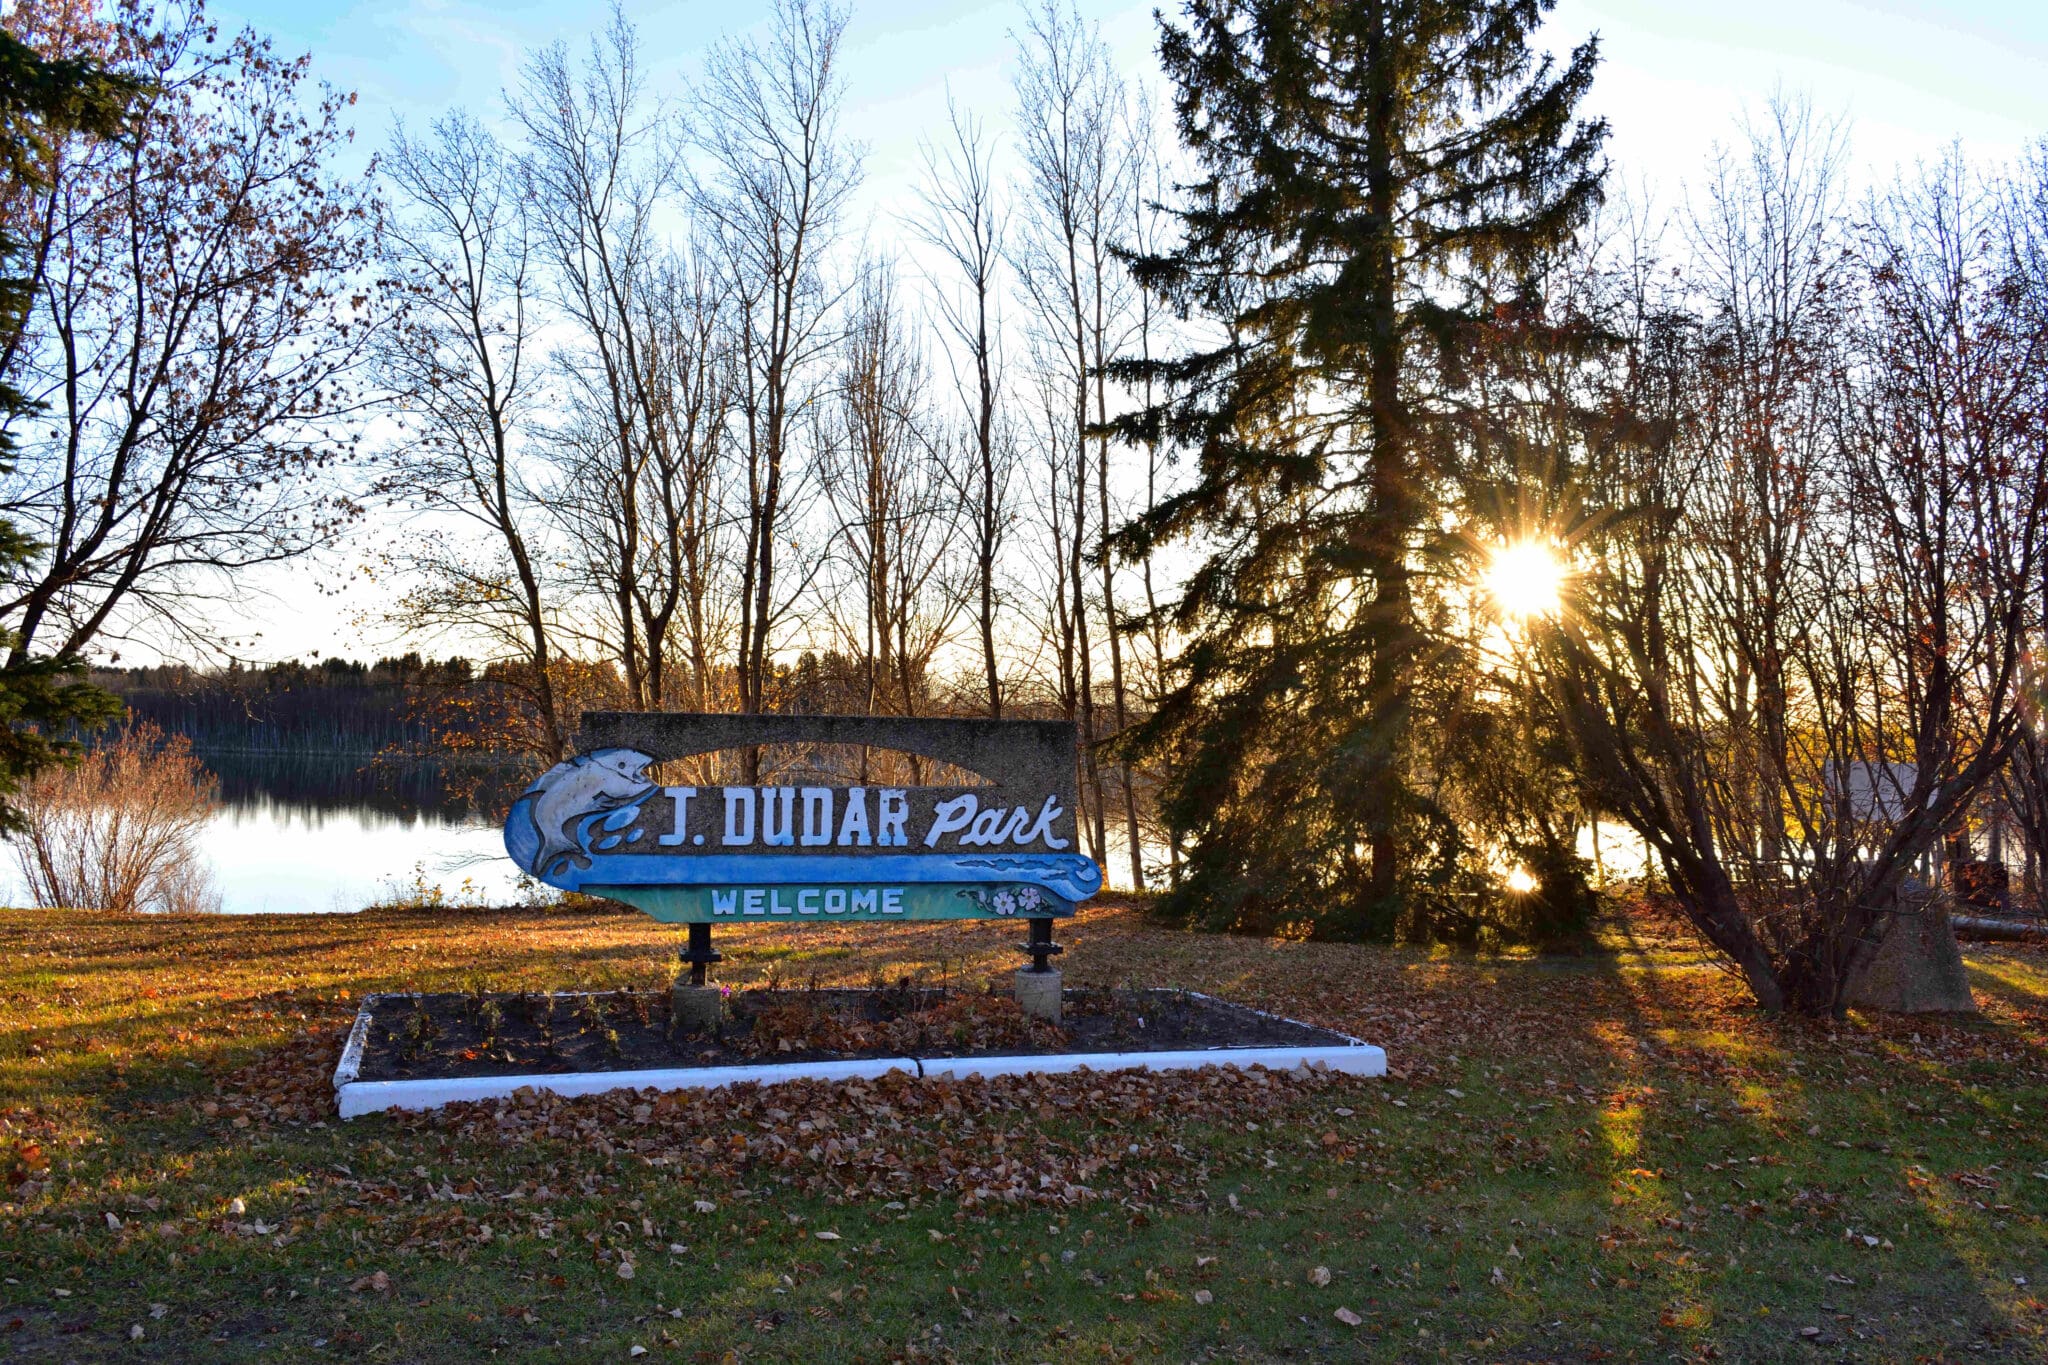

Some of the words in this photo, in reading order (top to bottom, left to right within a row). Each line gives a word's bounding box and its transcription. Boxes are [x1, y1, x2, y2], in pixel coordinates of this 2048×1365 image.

[660, 787, 704, 846] J.
[722, 787, 909, 847] DUDAR
[924, 794, 1068, 849] Park
[712, 889, 904, 915] WELCOME
